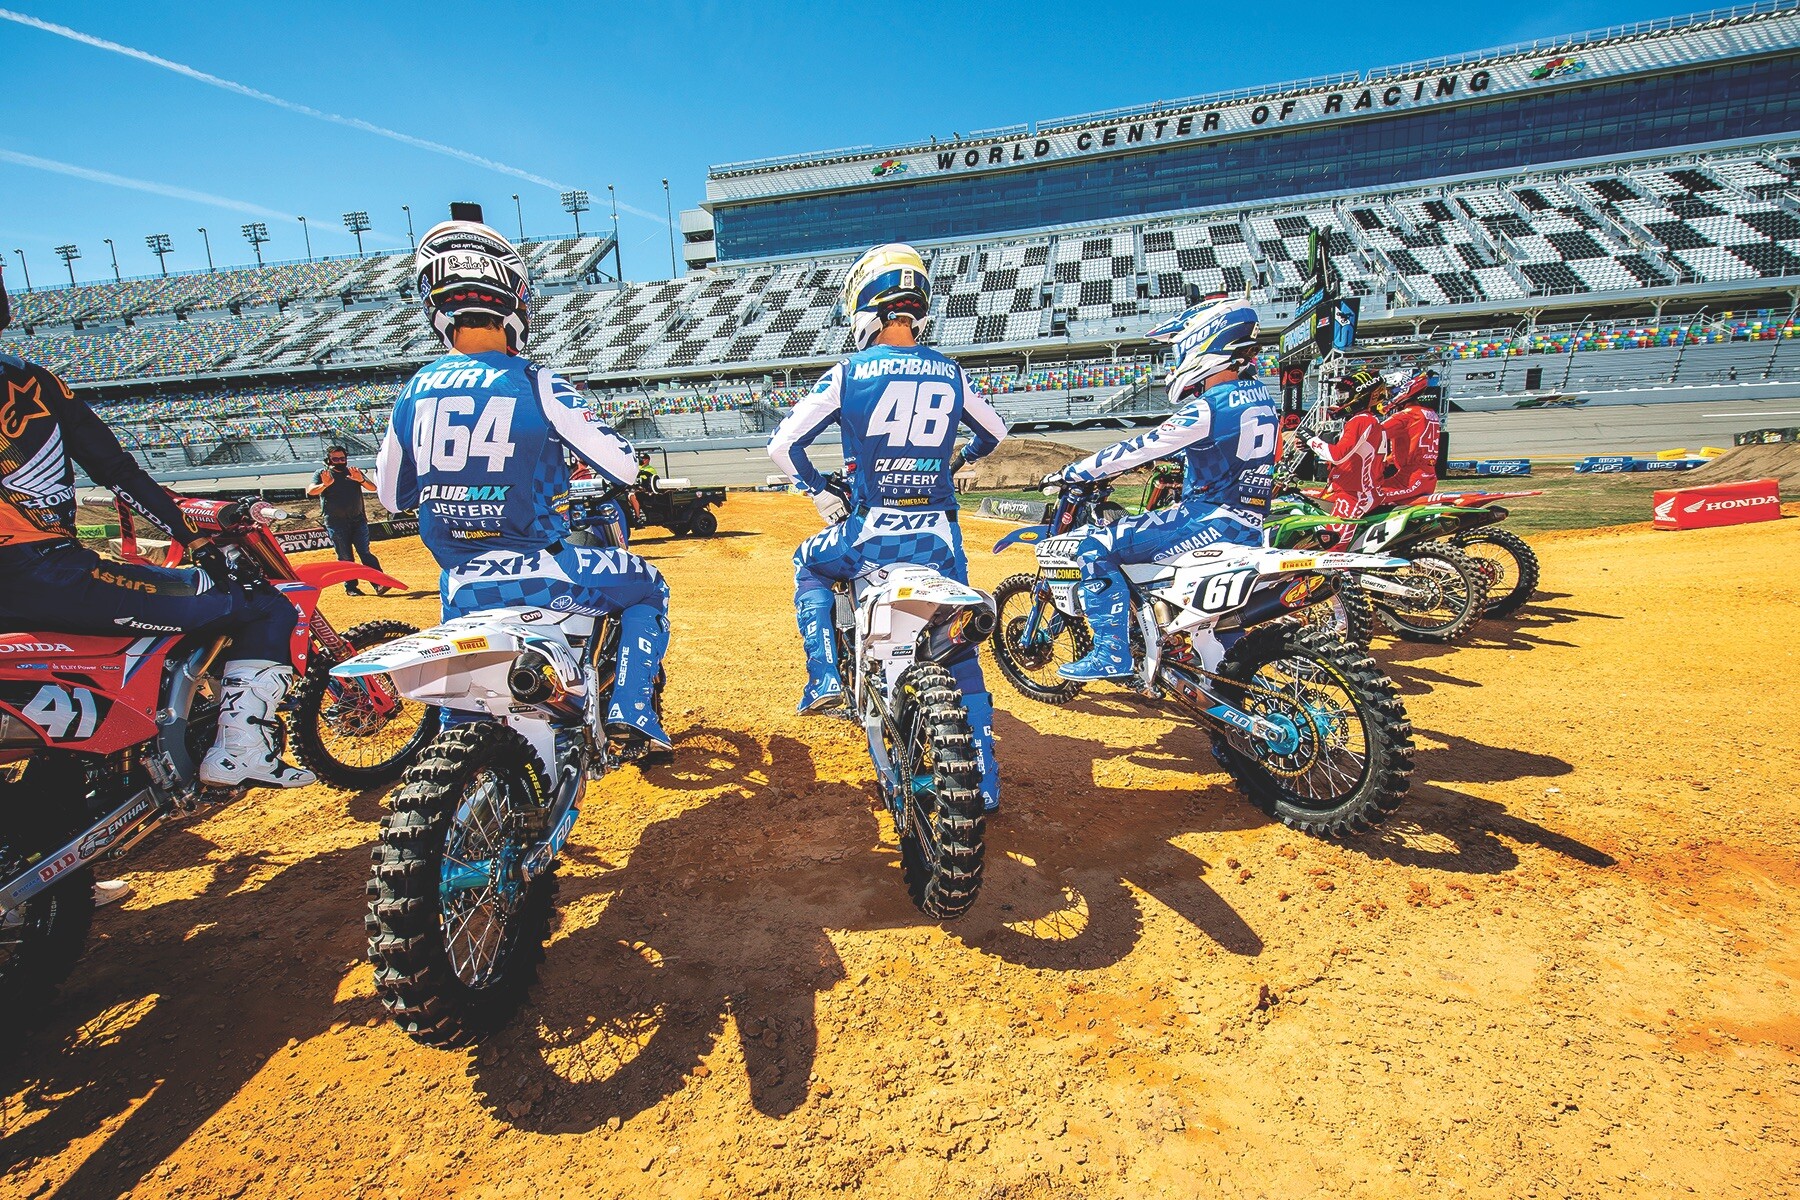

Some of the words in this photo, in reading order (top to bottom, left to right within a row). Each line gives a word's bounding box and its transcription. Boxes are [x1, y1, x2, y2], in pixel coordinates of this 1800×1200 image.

[937, 139, 1050, 170] WORLD
[1077, 112, 1221, 151] CENTER
[1251, 100, 1297, 125] OF
[1324, 71, 1490, 114] RACING
[1179, 314, 1228, 354] 100%
[853, 359, 956, 380] MARCHBANKS
[1355, 376, 1380, 392] OAKLEY
[865, 380, 956, 447] 48
[874, 458, 942, 472] CLUBMX
[878, 474, 938, 485] JEFFERY
[420, 484, 511, 504] CLUBMX
[432, 502, 505, 517] JEFFERY
[1705, 495, 1780, 512] HONDA
[285, 532, 308, 542] ROCKY
[1365, 521, 1390, 544] 4
[1166, 526, 1223, 558] YAMAHA
[1202, 570, 1253, 610] 61
[1110, 602, 1124, 614] G
[130, 620, 182, 632] HONDA
[457, 638, 487, 651] PIRELLI
[638, 636, 652, 654] G
[617, 646, 630, 687] GAERNE
[22, 684, 98, 738] 41
[609, 709, 619, 718] G
[636, 715, 648, 728] G
